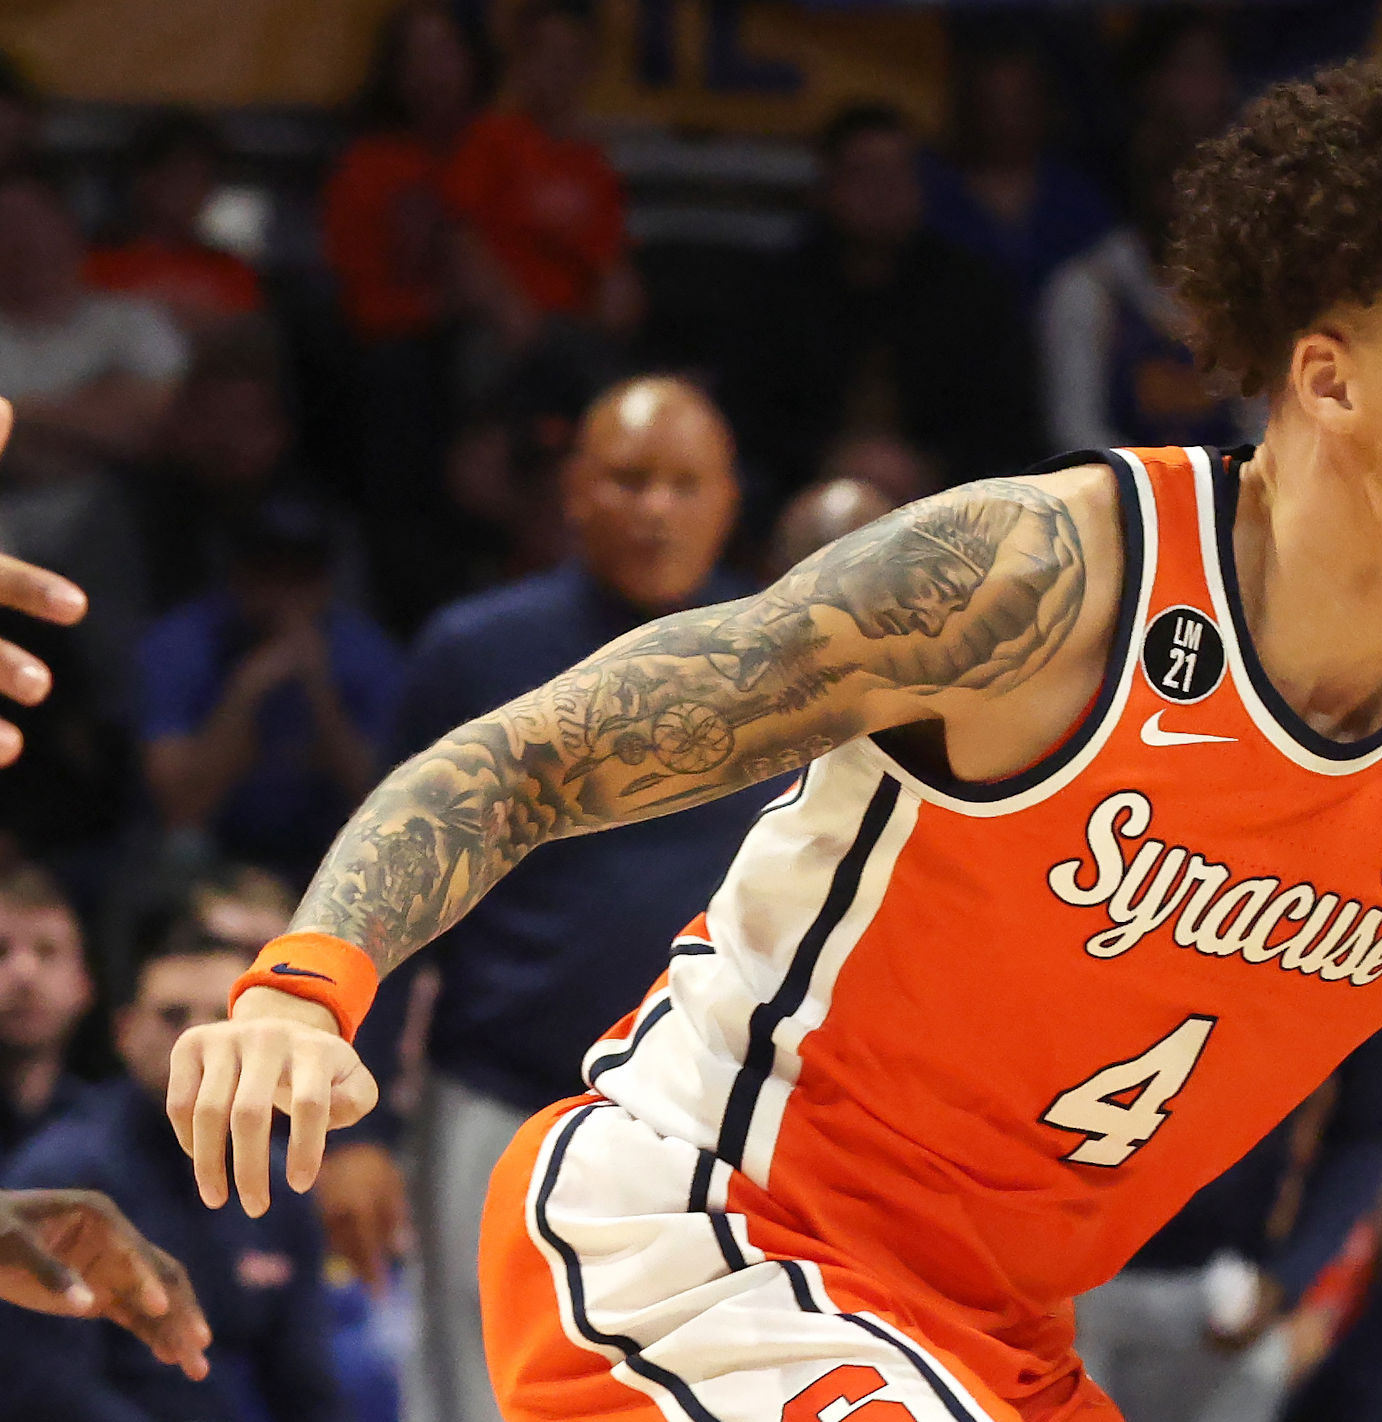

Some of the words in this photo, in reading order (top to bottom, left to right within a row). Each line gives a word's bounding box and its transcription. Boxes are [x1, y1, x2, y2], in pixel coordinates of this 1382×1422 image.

[1173, 616, 1203, 651] LM
[1162, 647, 1197, 692] 21
[1039, 1013, 1219, 1168] 4
